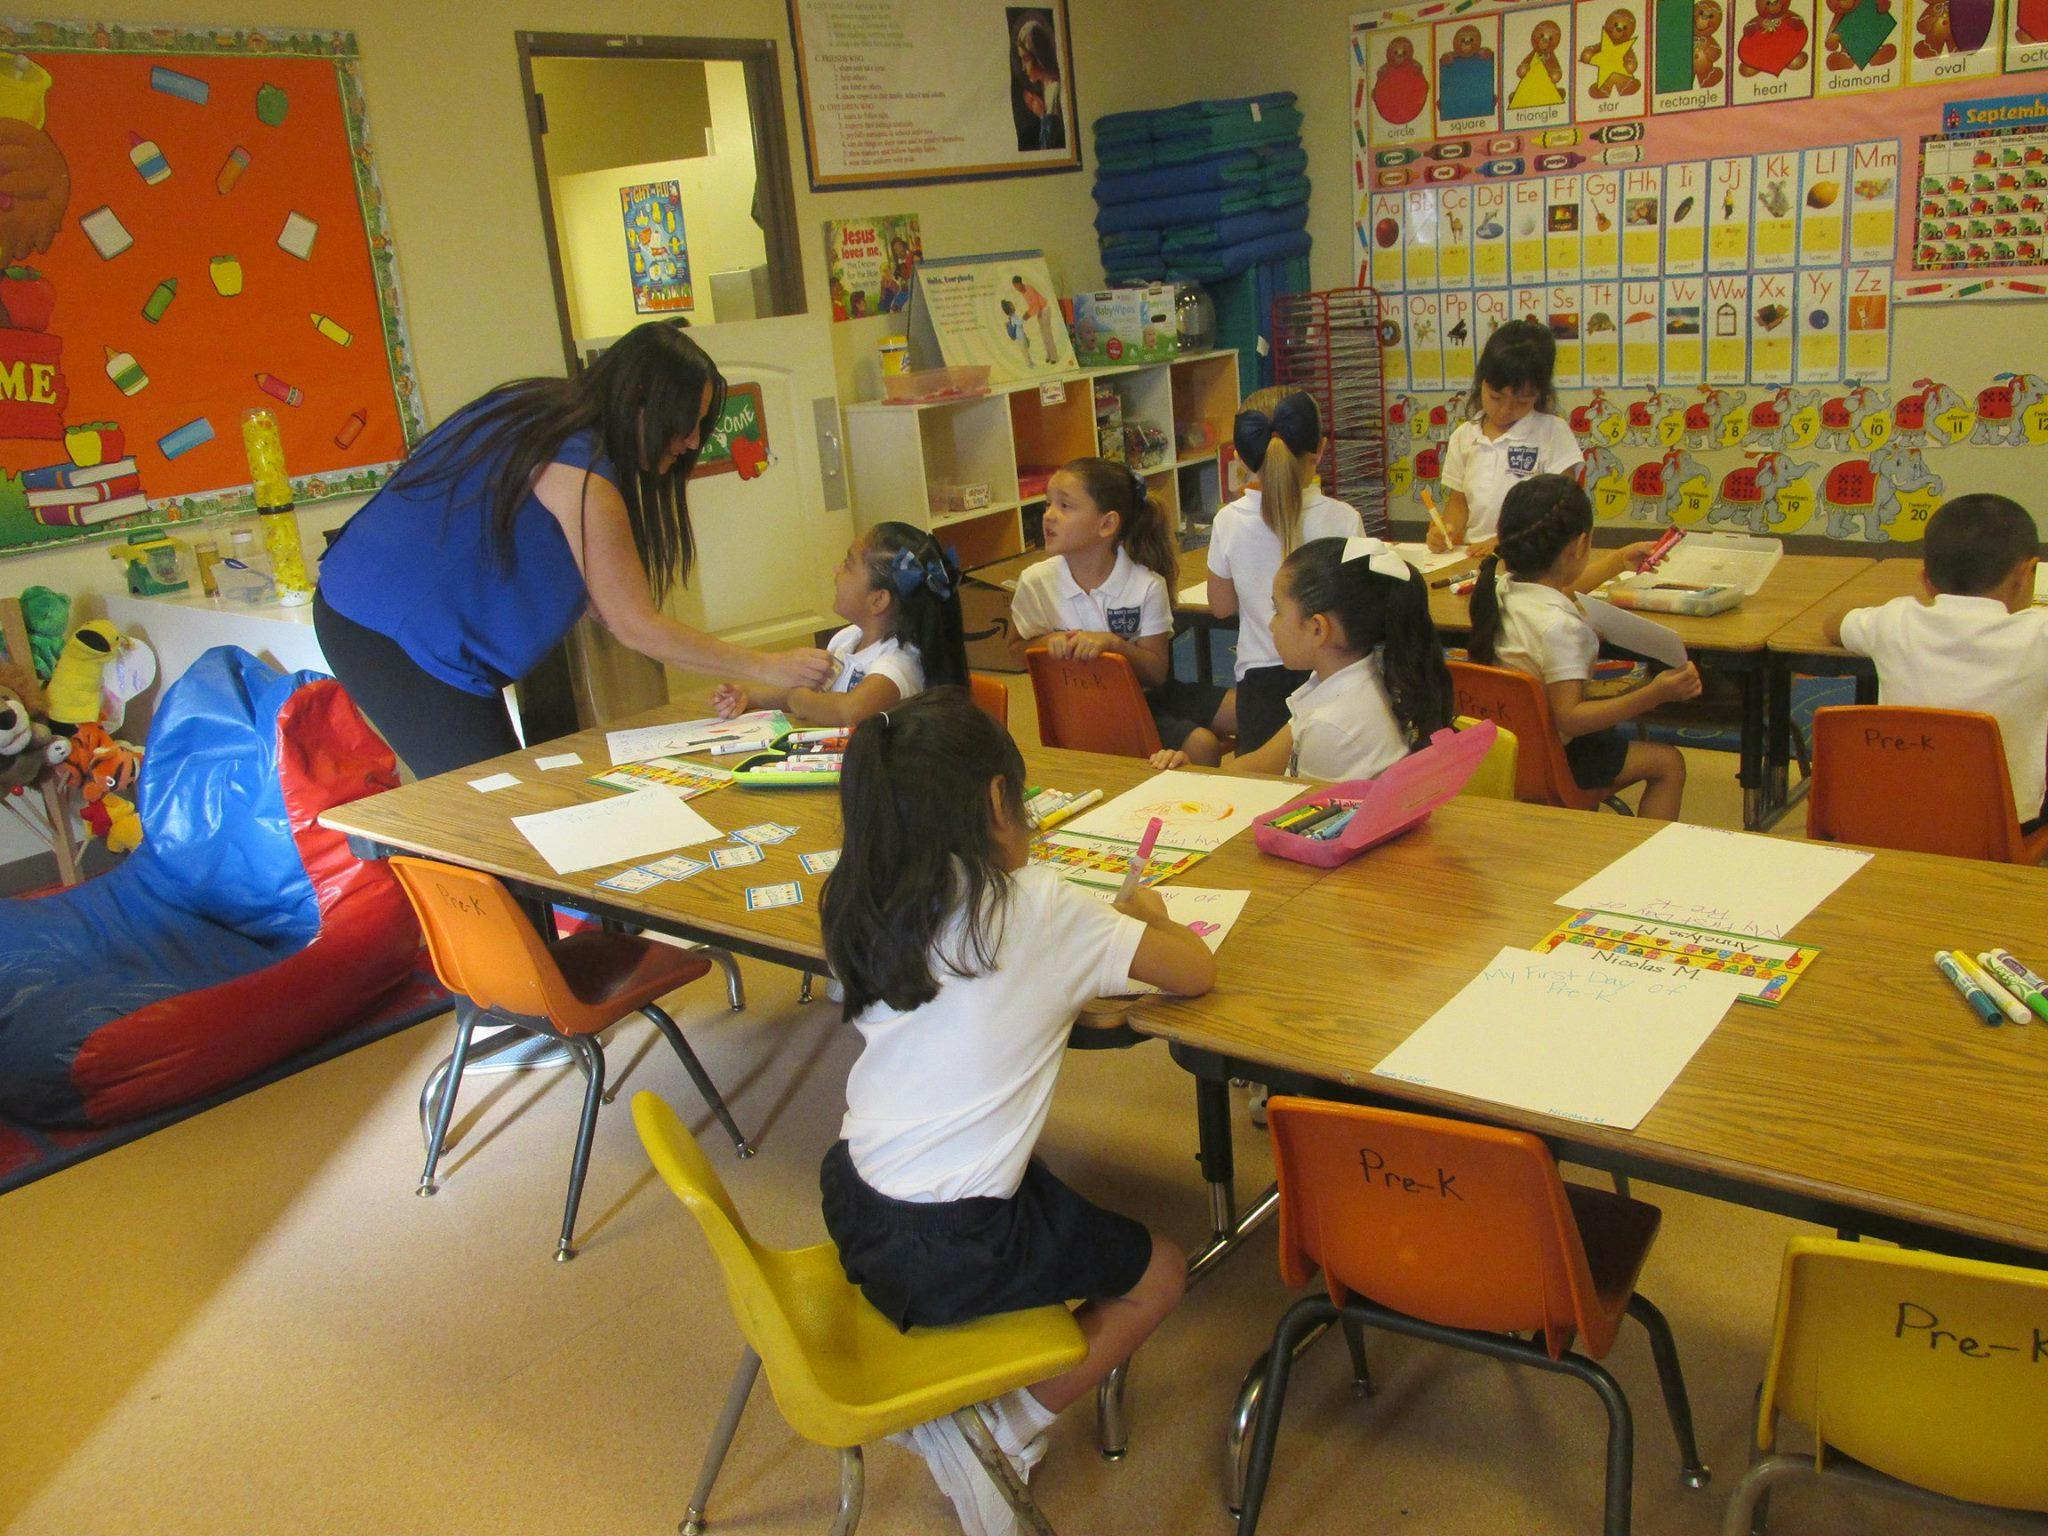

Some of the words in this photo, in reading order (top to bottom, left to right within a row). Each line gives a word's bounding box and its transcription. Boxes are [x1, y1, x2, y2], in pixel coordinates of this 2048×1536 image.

[1935, 58, 1965, 76] oval
[1828, 69, 1890, 89] diamond
[1660, 89, 1718, 109] rectangle
[1753, 82, 1787, 97] heart
[1516, 106, 1558, 123] triangle
[1598, 101, 1618, 113] star
[1967, 99, 2048, 124] Septemb
[1388, 124, 1415, 138] circle
[1450, 120, 1486, 133] square
[1816, 151, 1835, 174] Ll
[1855, 144, 1897, 169] Mm
[1680, 165, 1692, 187] Ii
[1719, 160, 1740, 191] Jj
[1766, 156, 1790, 178] Kk
[1554, 177, 1577, 199] Ff
[1586, 174, 1616, 204] Gg
[1628, 170, 1657, 192] Hh
[2013, 181, 2021, 190] 9
[1442, 190, 1467, 209] Cc
[1478, 186, 1504, 207] Dd
[1517, 183, 1538, 203] Ee
[1376, 196, 1400, 216] Aa
[842, 228, 875, 246] Jesus
[842, 247, 863, 259] loves
[1709, 279, 1746, 300] Ww
[1760, 276, 1785, 298] Xx
[1808, 272, 1832, 304] Yy
[1855, 269, 1881, 292] Zz
[1520, 290, 1541, 310] Rr
[1553, 288, 1574, 308] Ss
[1590, 285, 1611, 305] Tt
[1627, 284, 1654, 305] Uu
[1672, 281, 1696, 301] Vv
[1380, 297, 1400, 315] Nn
[1410, 297, 1436, 315] Oo
[1446, 294, 1467, 319] Pp
[1477, 293, 1508, 321] Qq
[0, 360, 57, 405] ME
[1416, 424, 1422, 434] 2
[1611, 428, 1619, 438] 6
[1667, 428, 1674, 438] 7
[1732, 426, 1740, 437] 8
[1801, 423, 1809, 434] 9
[1871, 424, 1883, 436] 10
[1953, 422, 1963, 434] 11
[1395, 473, 1404, 483] 14
[1606, 494, 1616, 505] 17
[1689, 499, 1700, 510] 18
[1788, 501, 1800, 512] 19
[1910, 509, 1928, 521] 20
[1591, 950, 1665, 975] Nicolas
[1672, 965, 1699, 981] M.
[1484, 968, 1515, 984] My
[1525, 965, 1579, 981] First
[1588, 971, 1634, 992] Day
